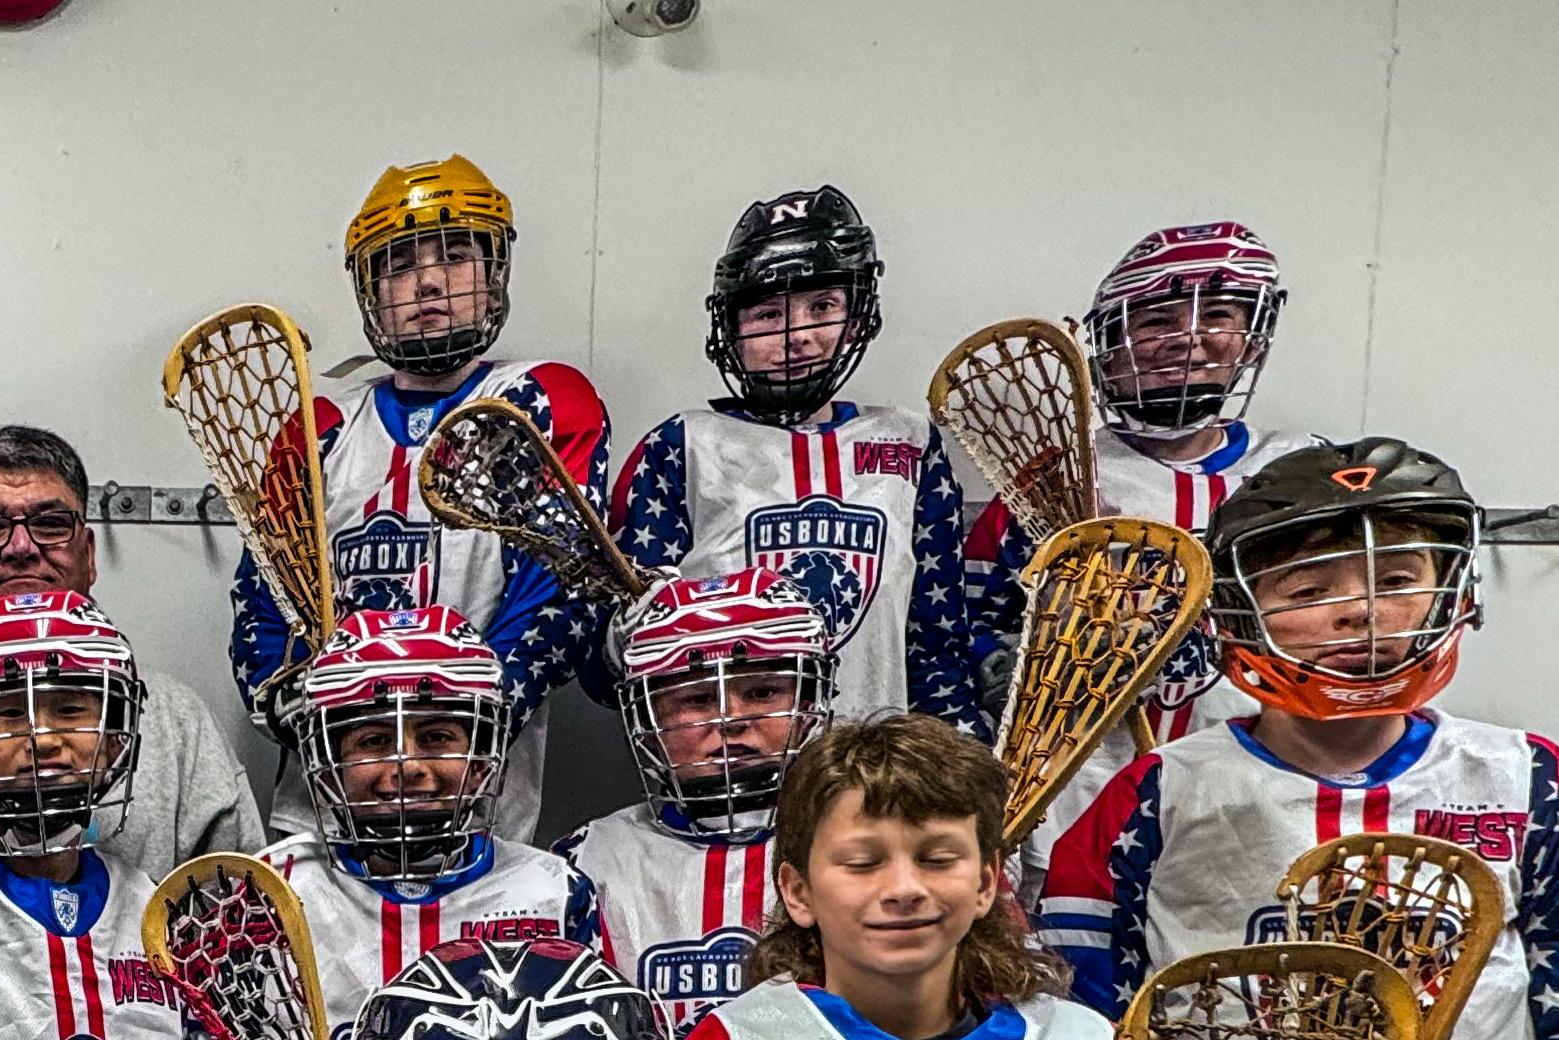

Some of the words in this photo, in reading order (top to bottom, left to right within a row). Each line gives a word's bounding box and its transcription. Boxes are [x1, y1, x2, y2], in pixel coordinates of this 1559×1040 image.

[770, 200, 809, 225] N
[853, 441, 922, 488] WEST
[759, 519, 874, 549] USBOXLA
[1414, 810, 1529, 868] WEST
